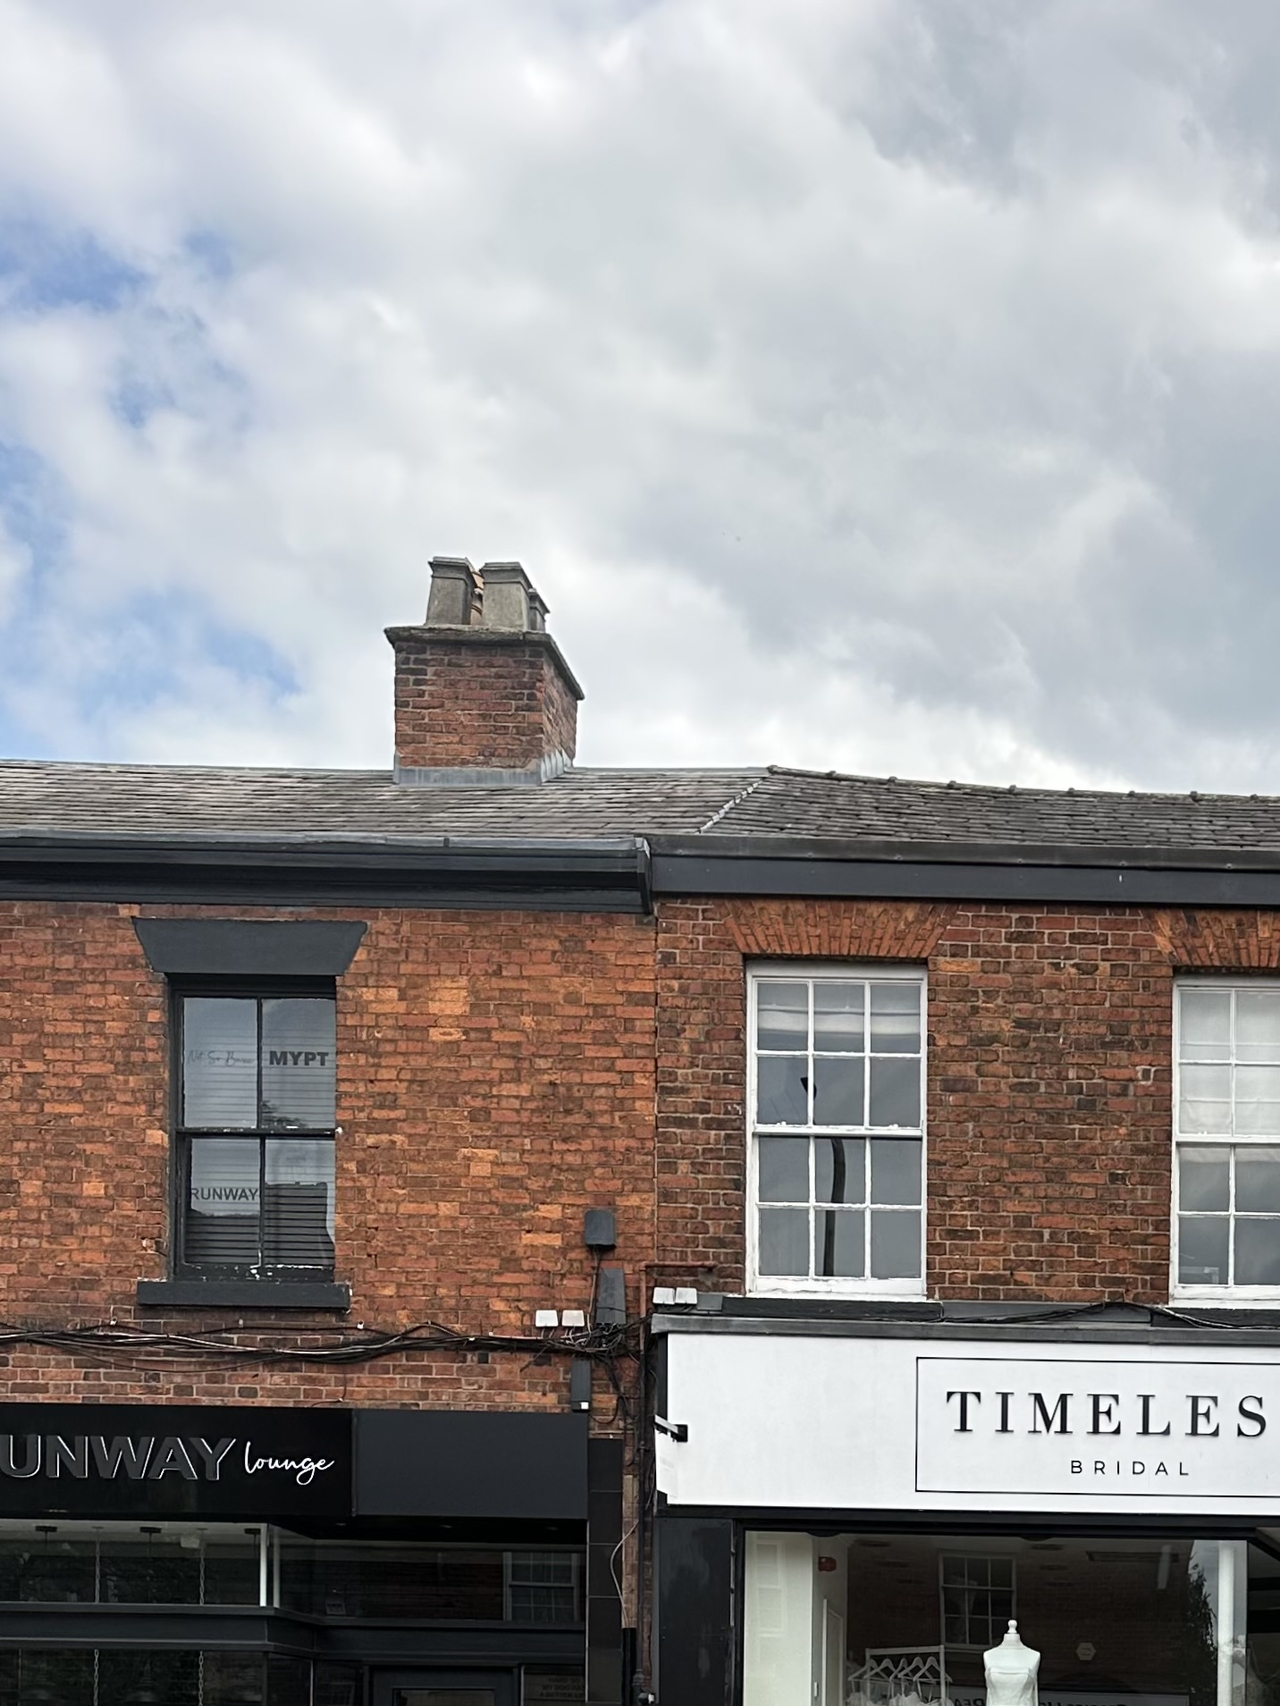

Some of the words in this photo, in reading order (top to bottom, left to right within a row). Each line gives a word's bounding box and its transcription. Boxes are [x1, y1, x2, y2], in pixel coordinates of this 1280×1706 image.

[269, 1051, 329, 1067] MYPT
[191, 1187, 259, 1201] RUNWAY
[244, 1440, 335, 1485] lounge
[1070, 1459, 1190, 1477] BRIDAL
